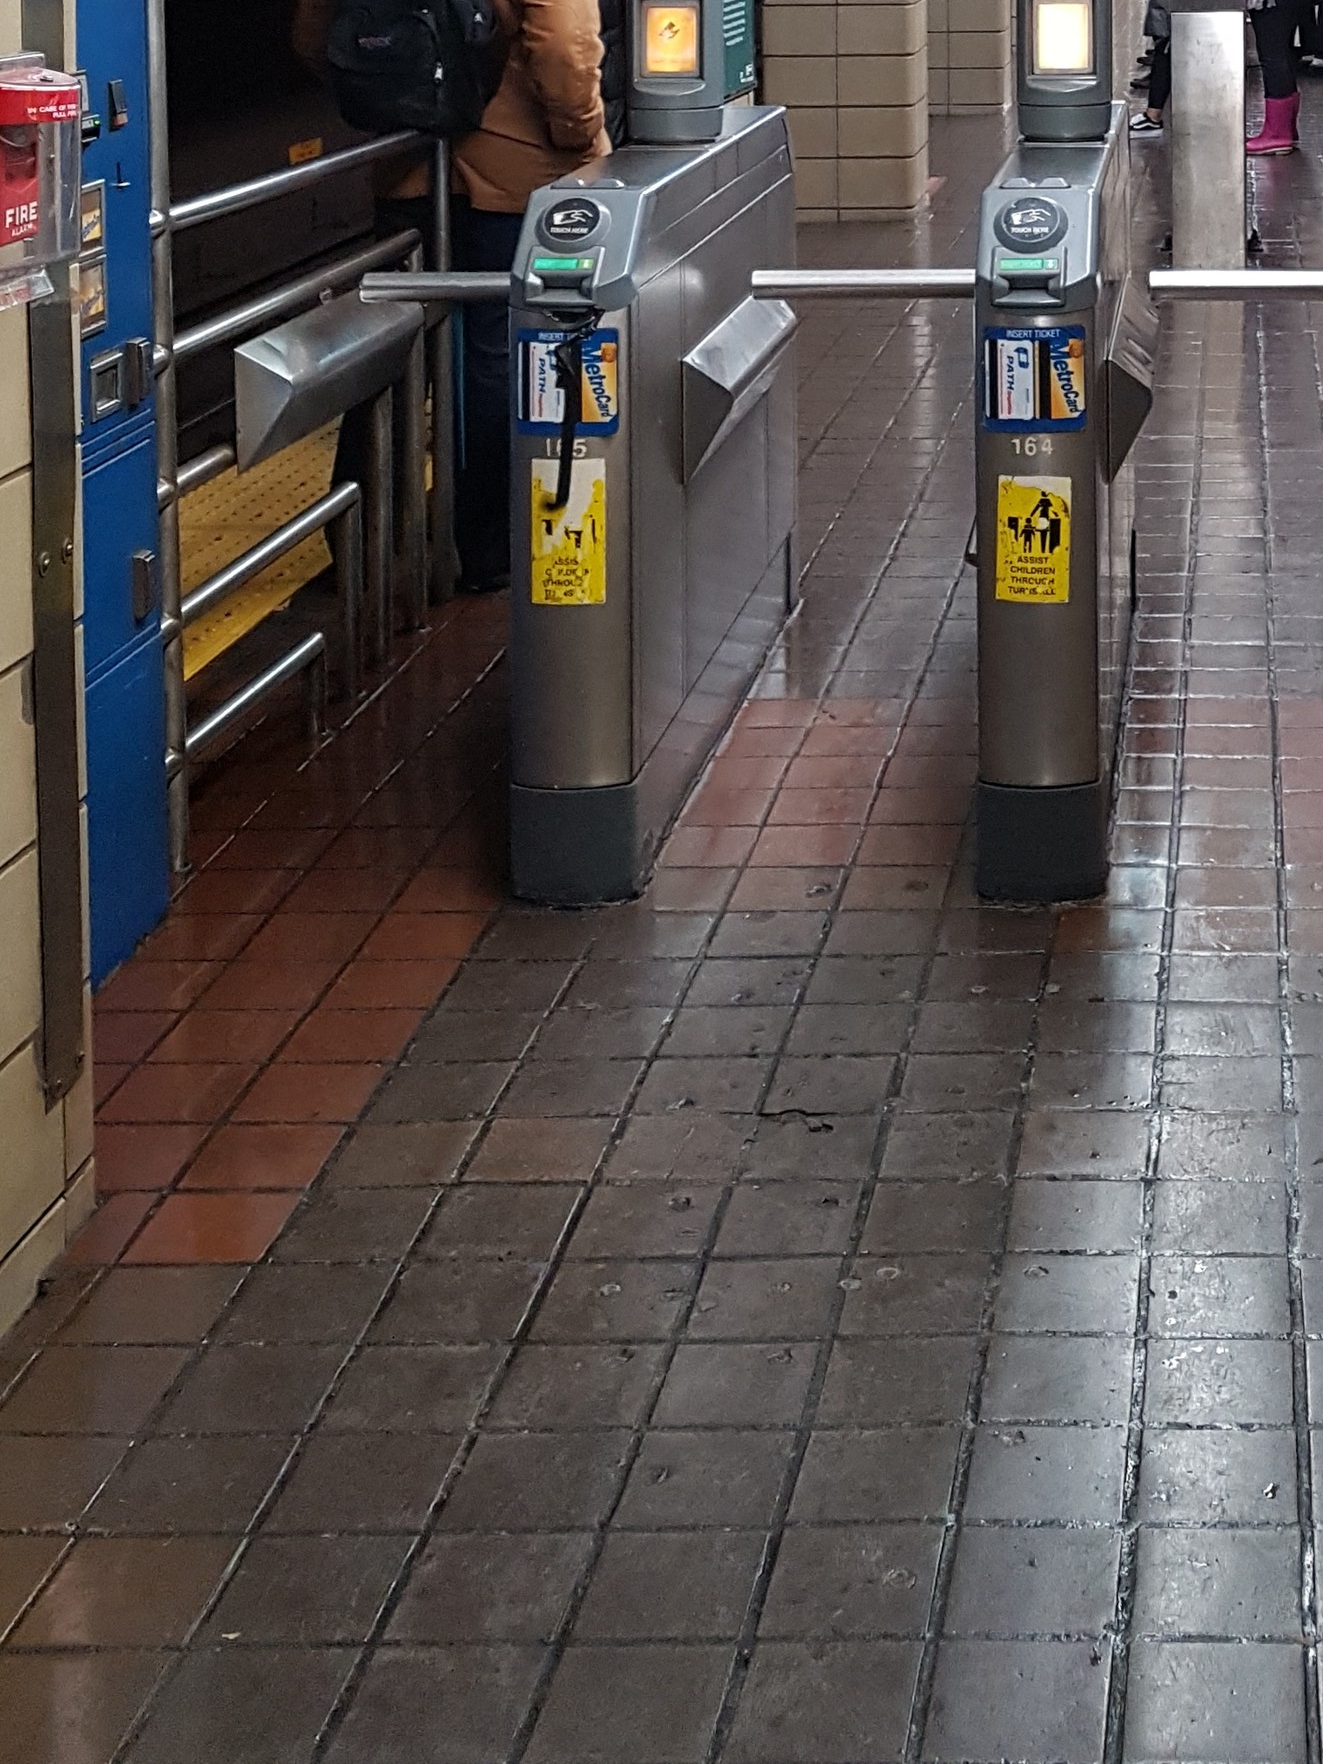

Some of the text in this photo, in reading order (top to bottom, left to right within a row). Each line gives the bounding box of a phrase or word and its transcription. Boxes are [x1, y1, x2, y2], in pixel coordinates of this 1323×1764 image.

[5, 201, 38, 228] FIRE
[1006, 328, 1060, 339] INSERT TICKET
[538, 357, 546, 393] PATH
[581, 344, 613, 417] MetroCard
[1006, 355, 1015, 391] PATH
[1048, 342, 1082, 413] MetroCard
[1011, 436, 1054, 457] 164
[1010, 566, 1056, 575] CHILDREN
